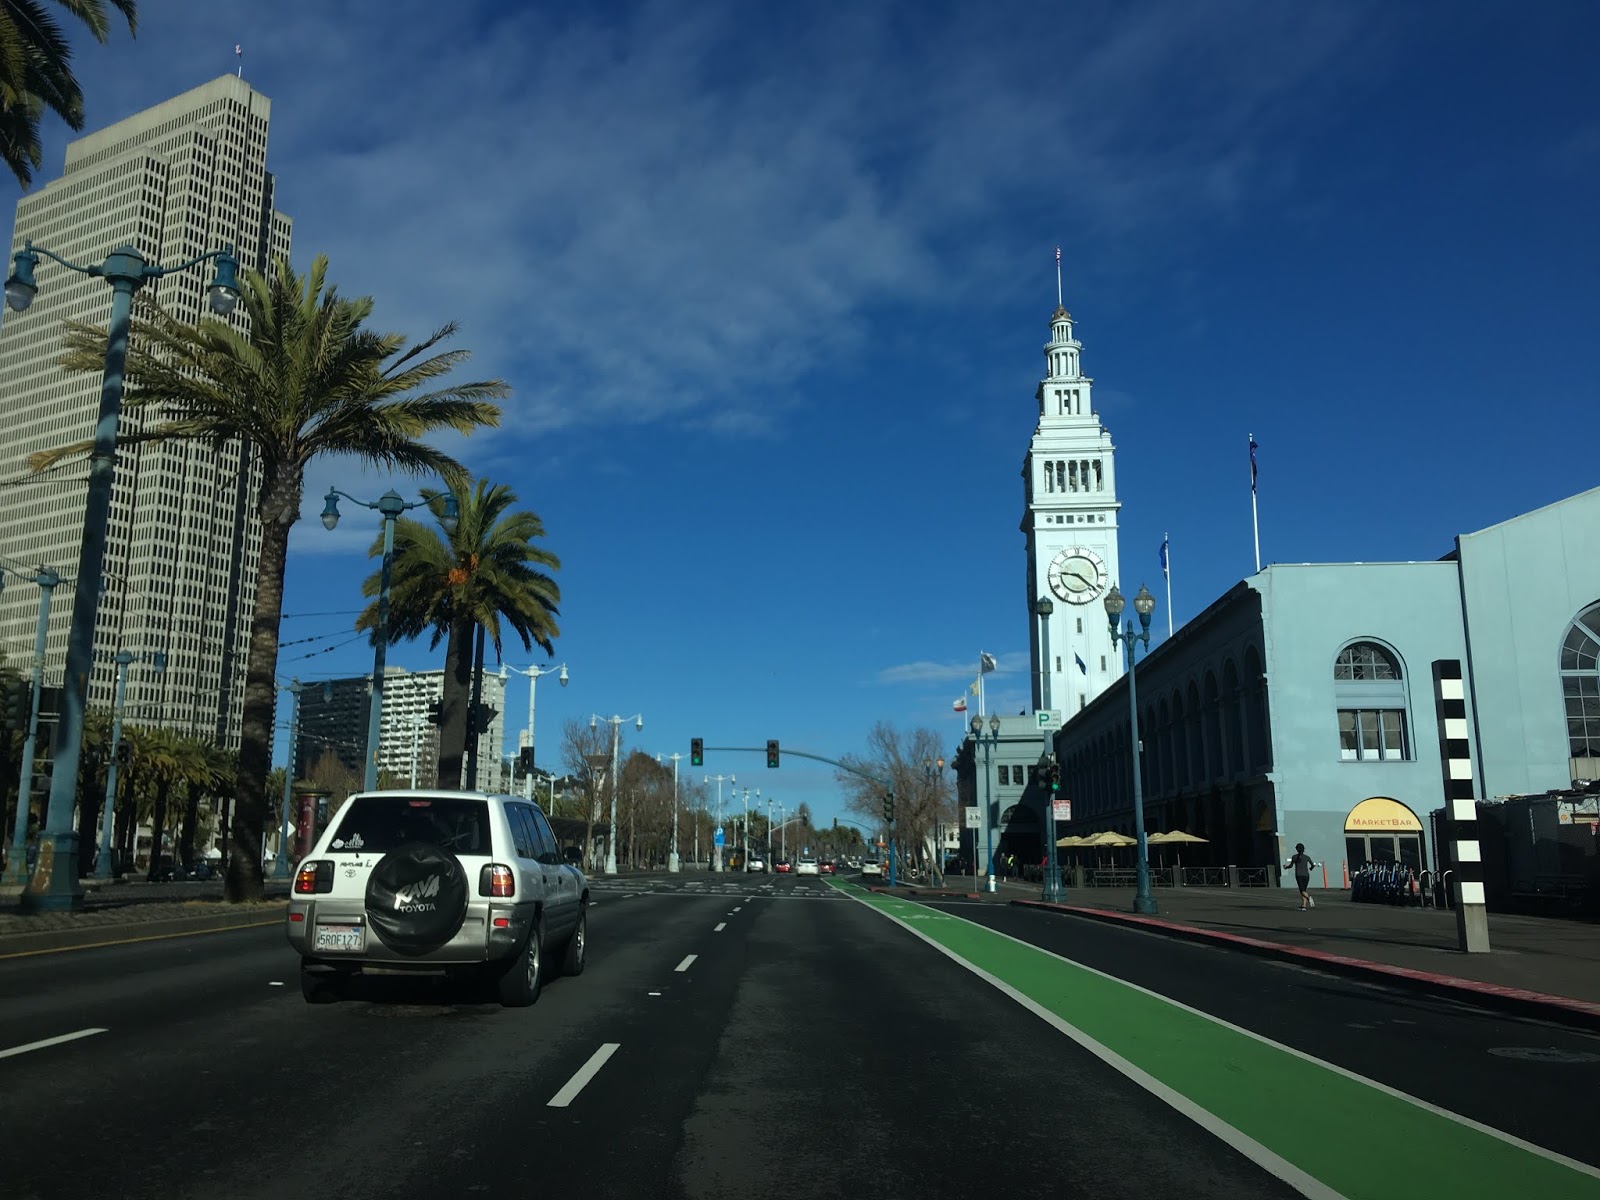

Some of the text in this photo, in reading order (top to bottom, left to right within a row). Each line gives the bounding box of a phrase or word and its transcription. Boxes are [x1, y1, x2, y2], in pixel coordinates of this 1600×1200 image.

[1352, 818, 1412, 826] MARKETBAR
[394, 874, 440, 910] RAV4
[399, 903, 436, 913] TOYOTA
